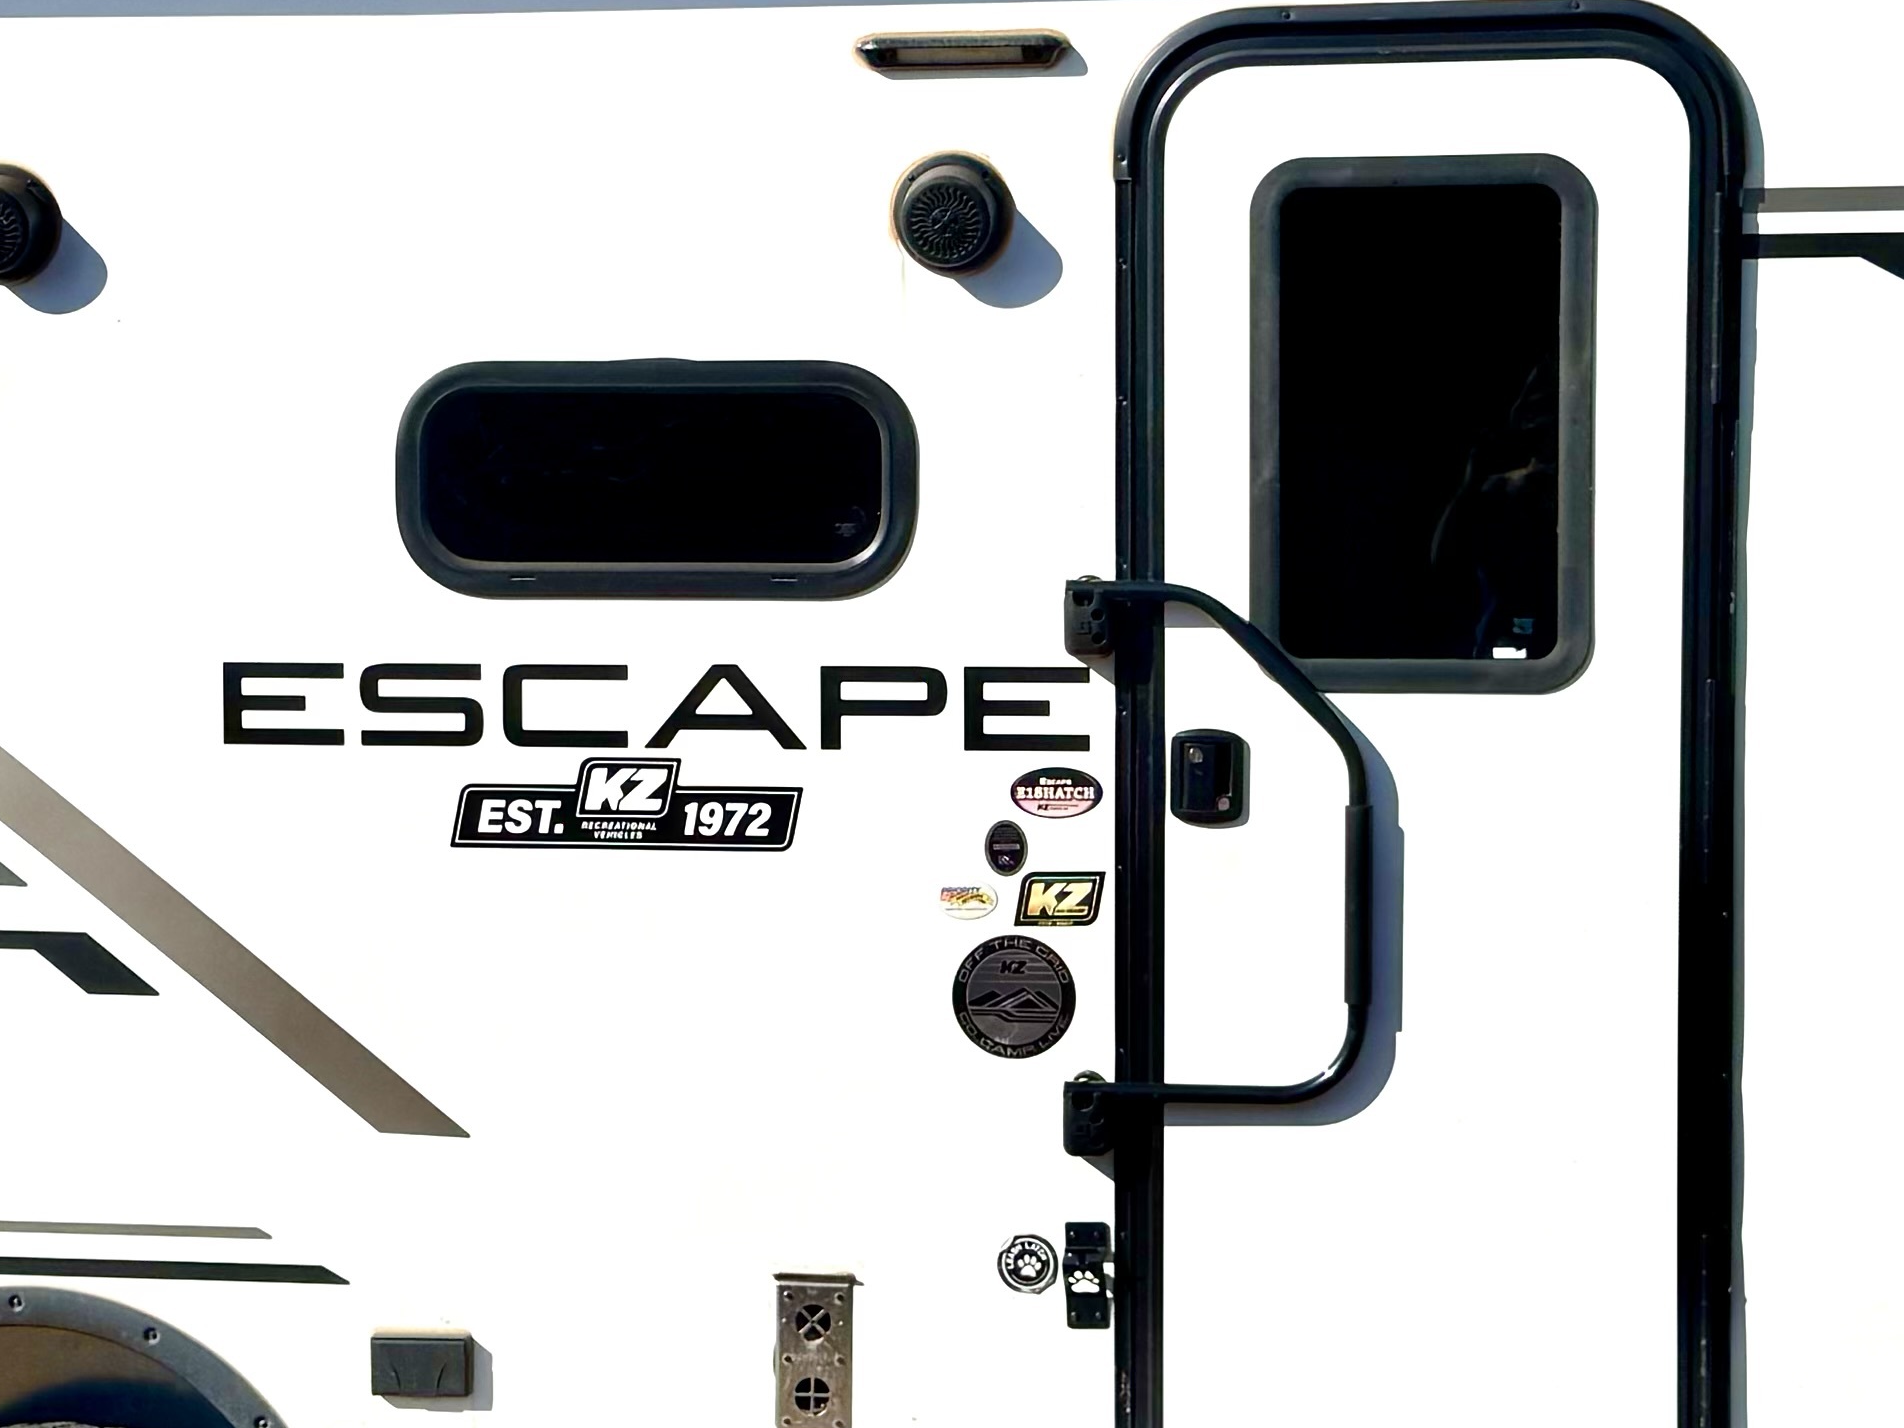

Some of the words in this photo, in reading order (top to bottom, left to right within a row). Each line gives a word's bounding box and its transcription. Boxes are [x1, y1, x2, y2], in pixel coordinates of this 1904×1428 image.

[222, 662, 1091, 751] ESCAPE
[583, 767, 669, 811] KZ
[1016, 786, 1095, 800] E18HATCH
[477, 799, 564, 834] EST.
[683, 801, 772, 837] 1972
[581, 821, 656, 831] RECREATIONAL
[594, 830, 643, 839] VEHICLES
[1027, 881, 1093, 916] KZ
[958, 947, 985, 983] OFF
[989, 937, 1032, 950] THE
[1036, 945, 1070, 984] GRID
[999, 960, 1029, 974] KZ
